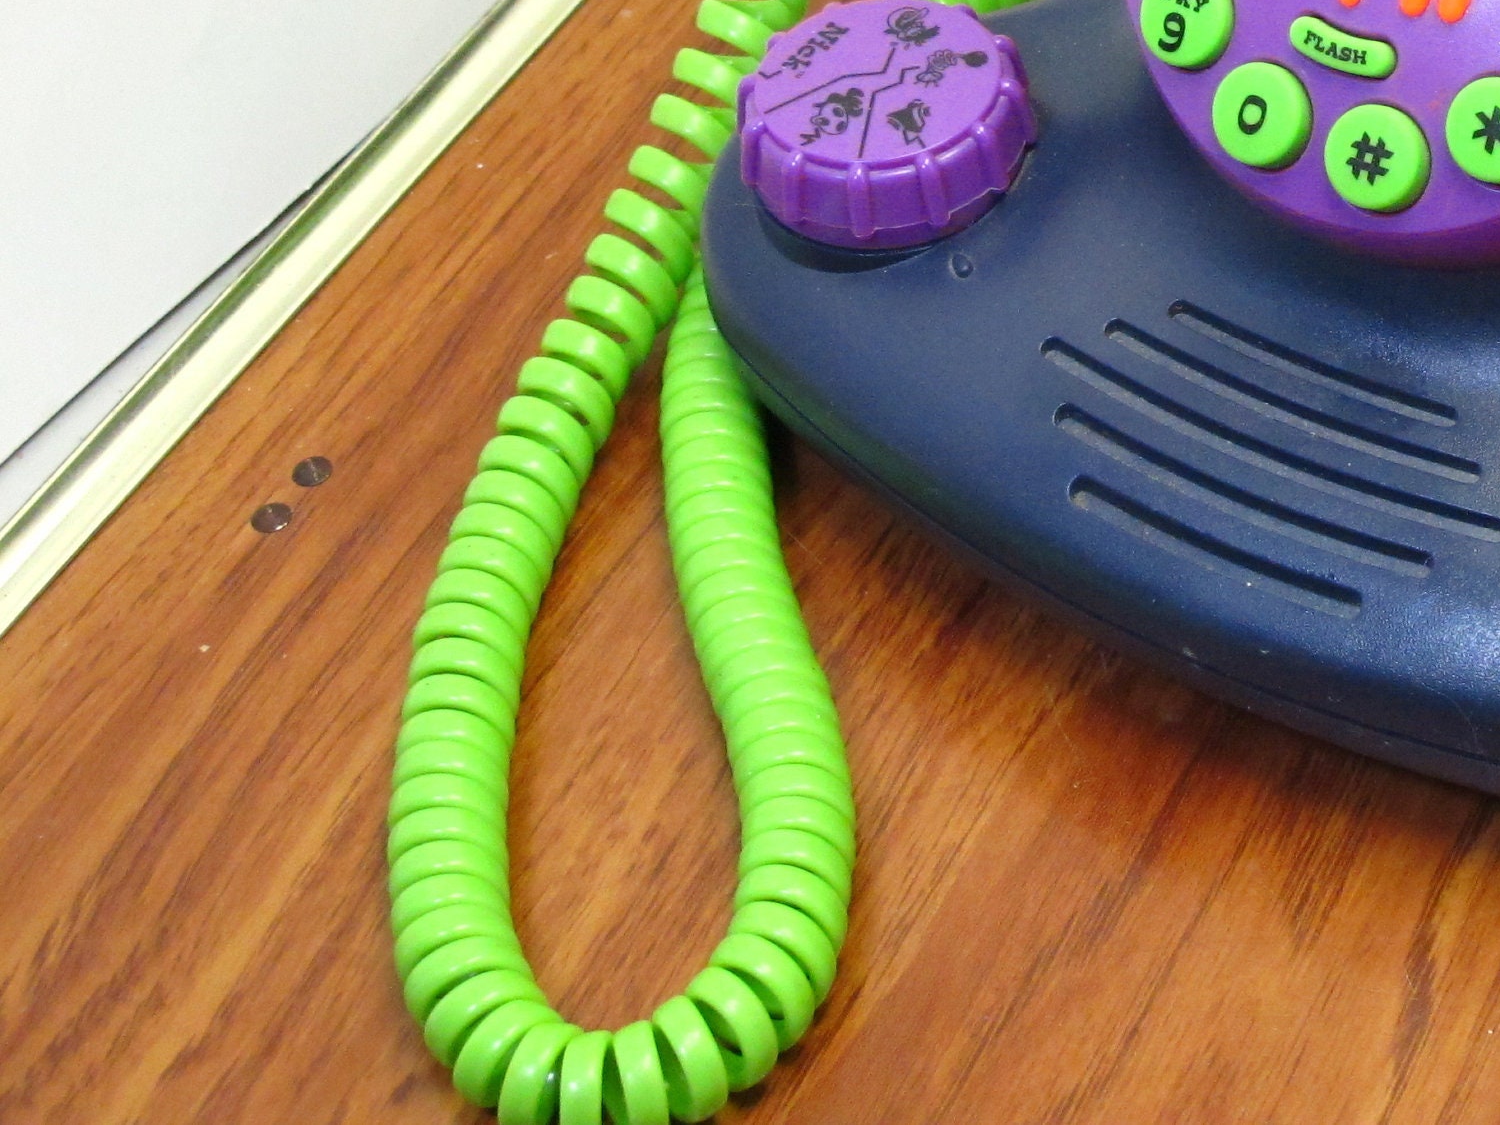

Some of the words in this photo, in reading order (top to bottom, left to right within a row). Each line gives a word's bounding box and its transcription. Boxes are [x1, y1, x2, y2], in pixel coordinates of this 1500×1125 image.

[1158, 12, 1186, 53] 9
[1303, 30, 1367, 65] FLASH
[1345, 131, 1394, 186] #
